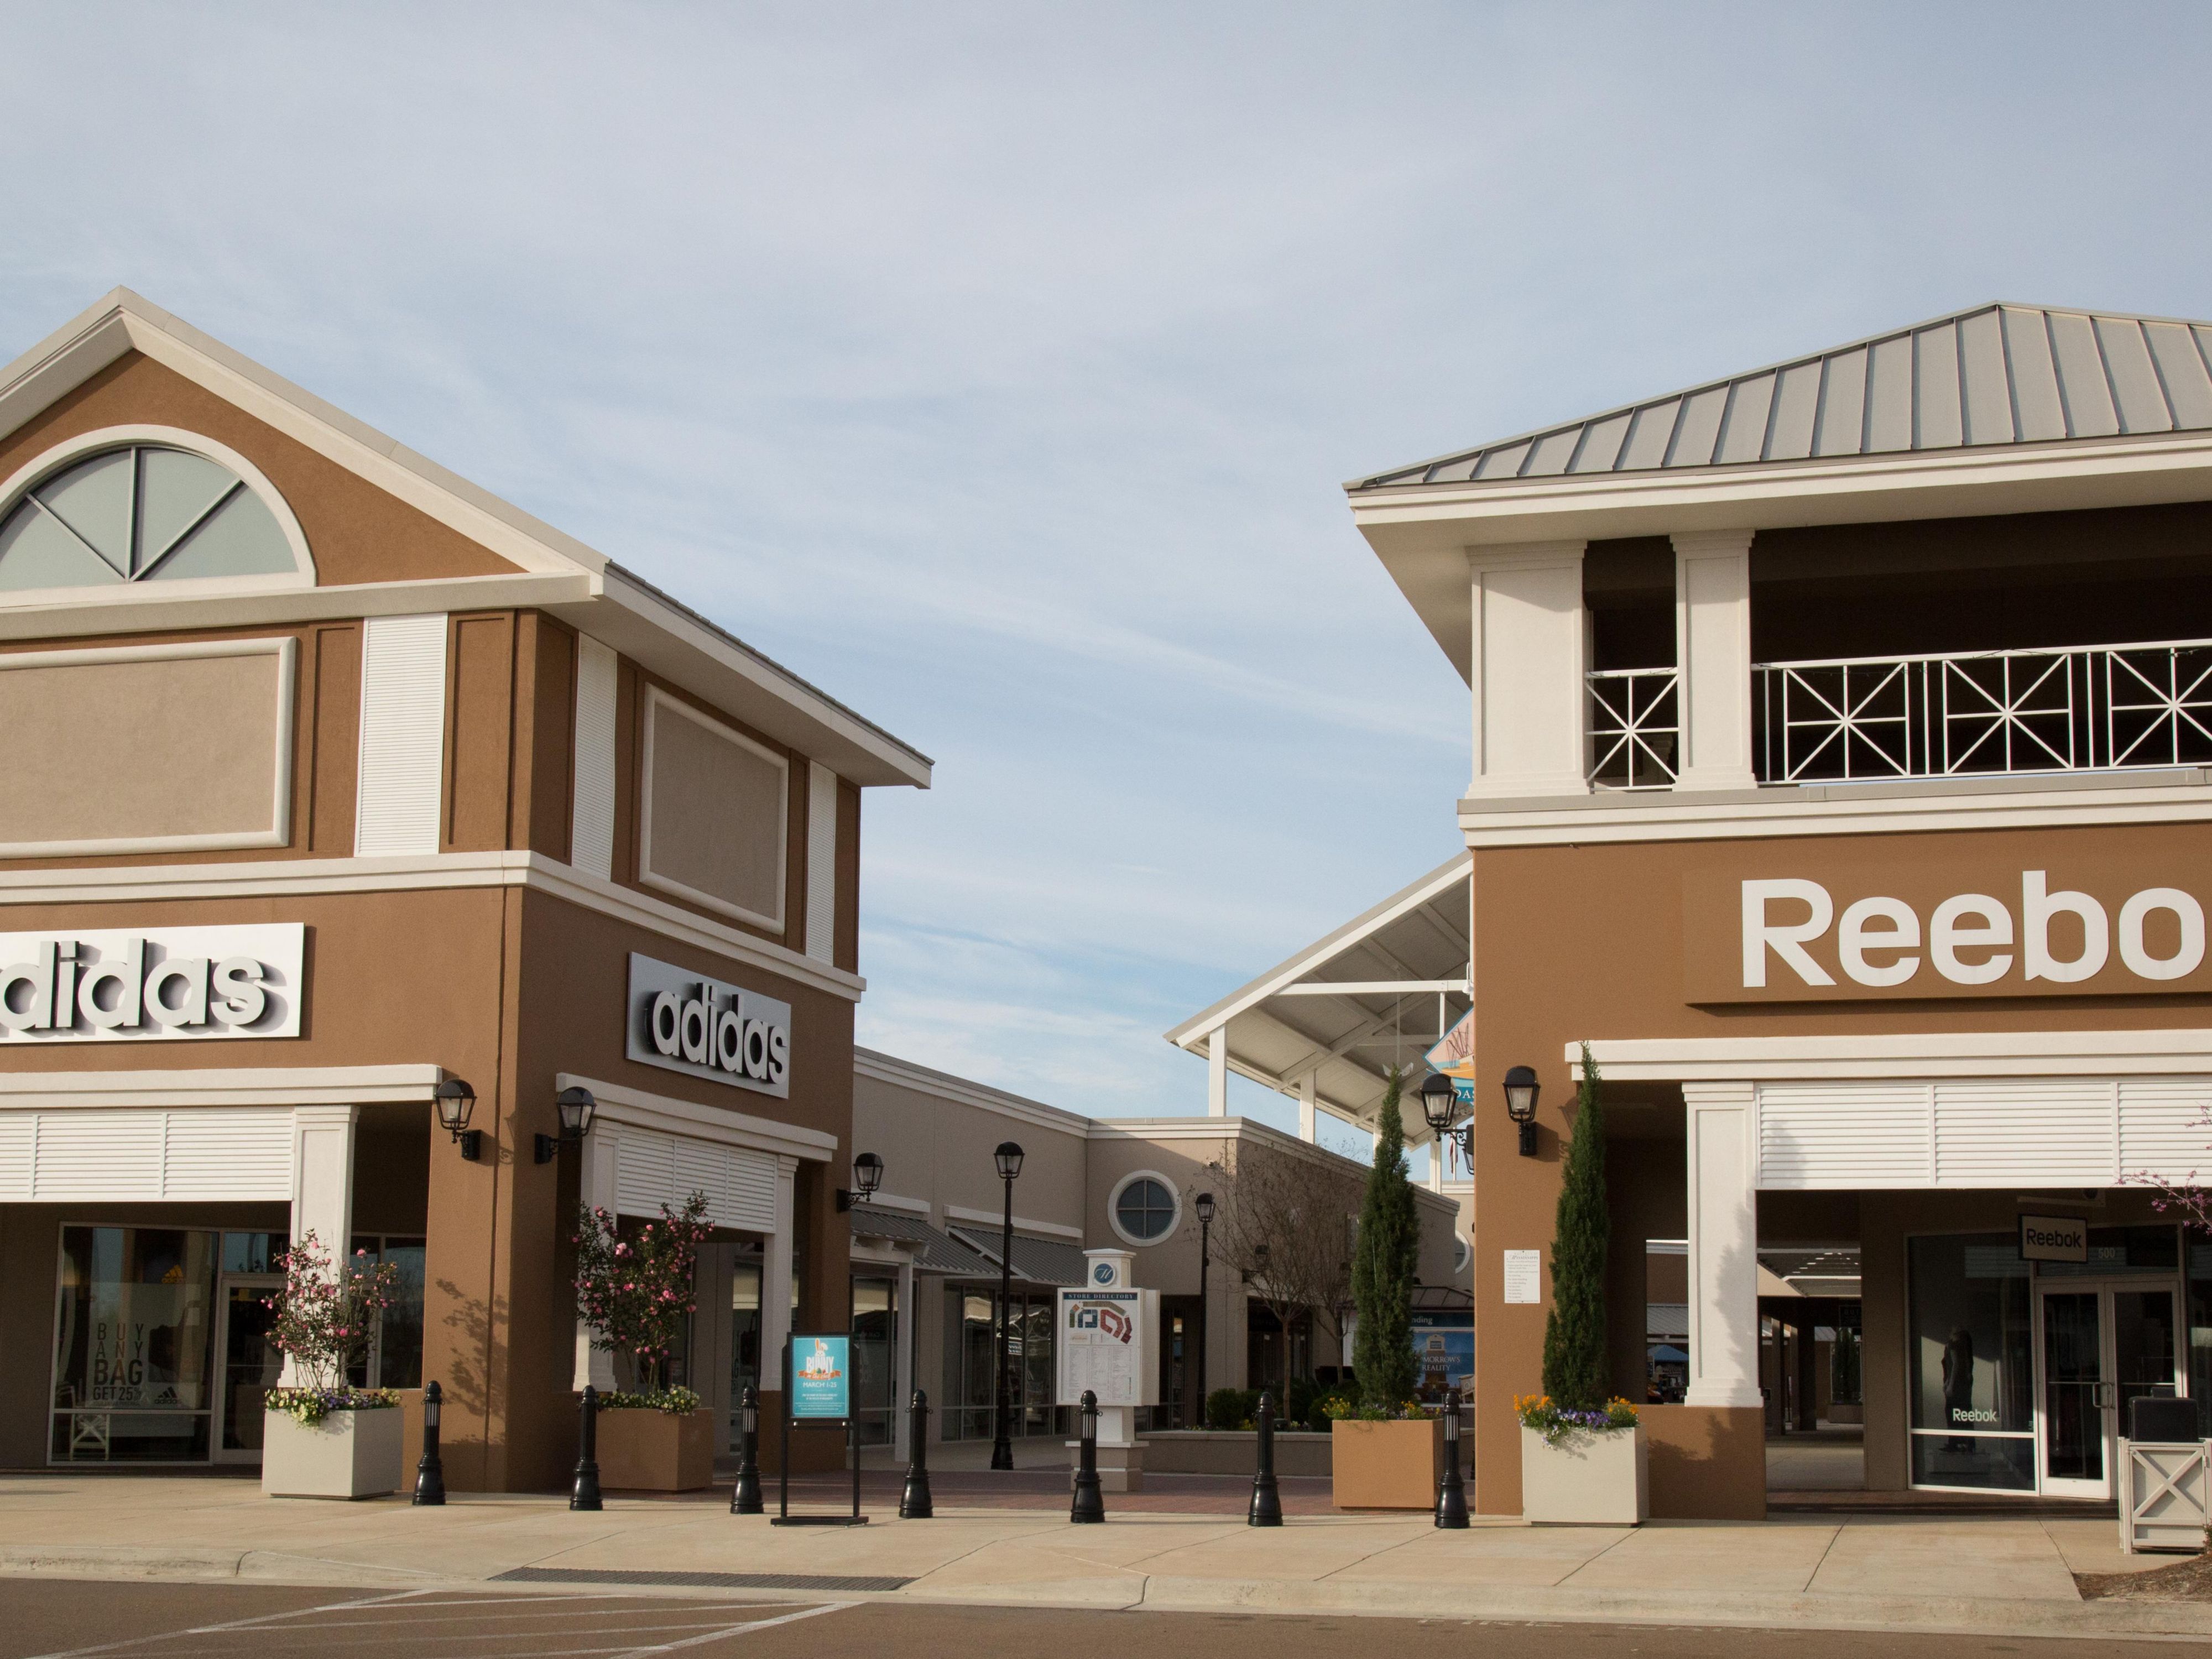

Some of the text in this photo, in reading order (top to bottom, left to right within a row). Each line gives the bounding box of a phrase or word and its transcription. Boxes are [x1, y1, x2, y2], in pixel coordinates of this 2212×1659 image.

[1741, 870, 2206, 988] Reebo
[0, 938, 266, 1030] didas
[650, 982, 789, 1084] adidas
[2026, 1228, 2082, 1248] Reebok
[2098, 1248, 2115, 1259] 500
[97, 1323, 144, 1341] BUY
[96, 1340, 144, 1359] ANY
[93, 1359, 144, 1386] BAG
[806, 1356, 834, 1373] BUNNY
[93, 1386, 116, 1400] GET
[1953, 1408, 1997, 1422] Reebok
